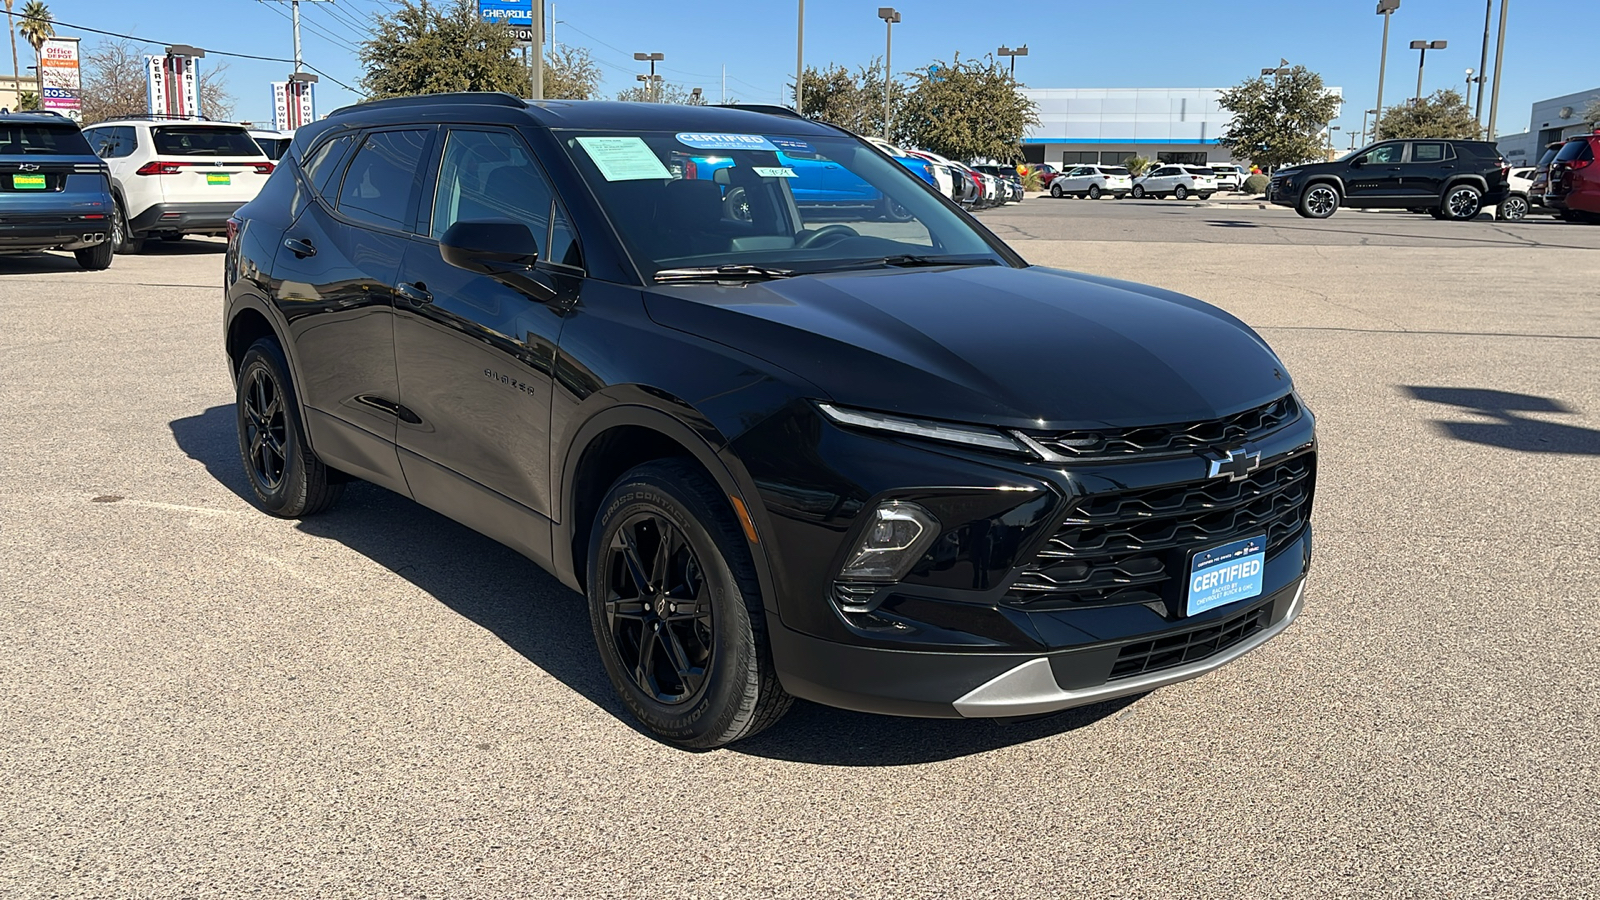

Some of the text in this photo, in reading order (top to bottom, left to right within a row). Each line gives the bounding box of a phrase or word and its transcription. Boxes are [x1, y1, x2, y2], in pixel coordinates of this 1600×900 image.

[483, 9, 532, 18] CHEVROLE
[44, 89, 71, 97] ROSS
[679, 134, 765, 143] CERTIFIED
[484, 368, 535, 396] BLAZER
[1193, 560, 1260, 592] CERTIFIED
[1196, 592, 1222, 606] CHEVROLET
[1223, 588, 1238, 597] BUICK
[1243, 583, 1253, 591] GMC
[1212, 585, 1230, 594] BACKED
[617, 678, 710, 729] CONTINENTAL
